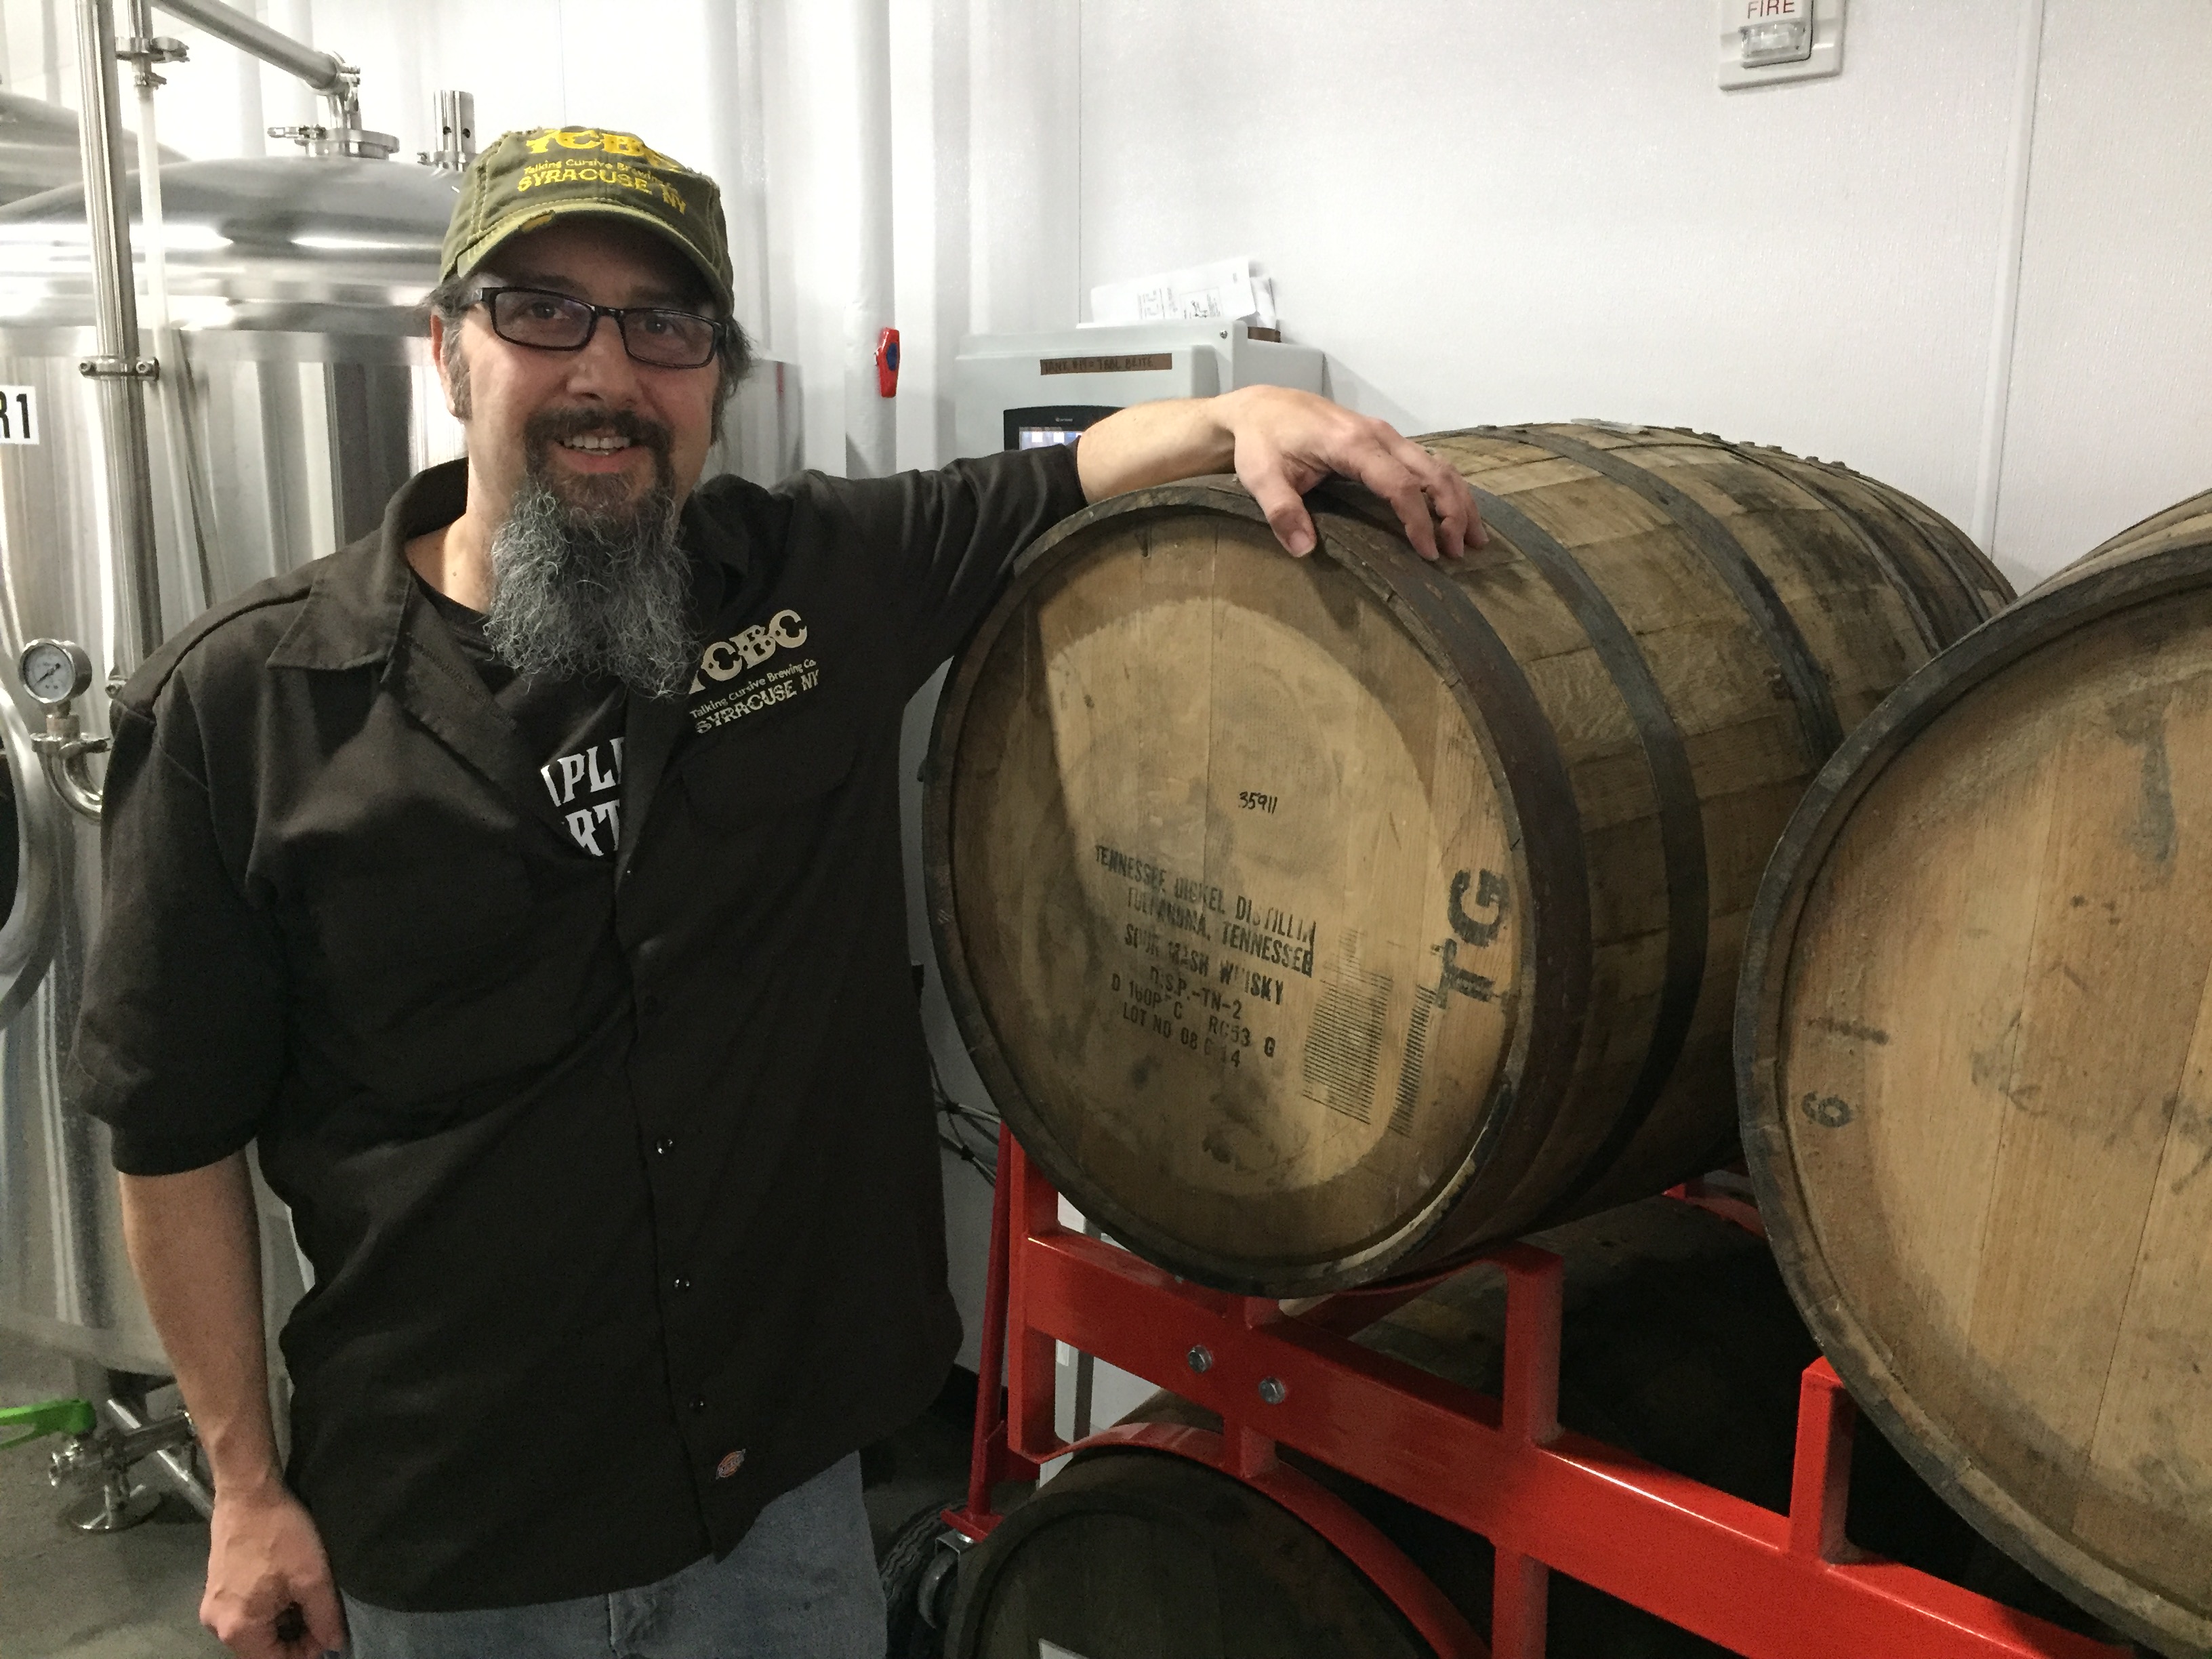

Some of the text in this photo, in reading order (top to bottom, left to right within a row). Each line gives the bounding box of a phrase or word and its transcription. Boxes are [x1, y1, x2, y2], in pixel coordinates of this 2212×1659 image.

[1747, 0, 1795, 18] FIRE
[517, 168, 653, 192] SYRACUSE
[659, 184, 687, 215] NY
[689, 697, 729, 719] Talking
[729, 678, 766, 701] Cursive
[766, 663, 803, 682] Brewing
[695, 669, 819, 734] SYRACUSE NY
[1122, 1002, 1147, 1027] LOT
[1152, 1014, 1172, 1039] NO
